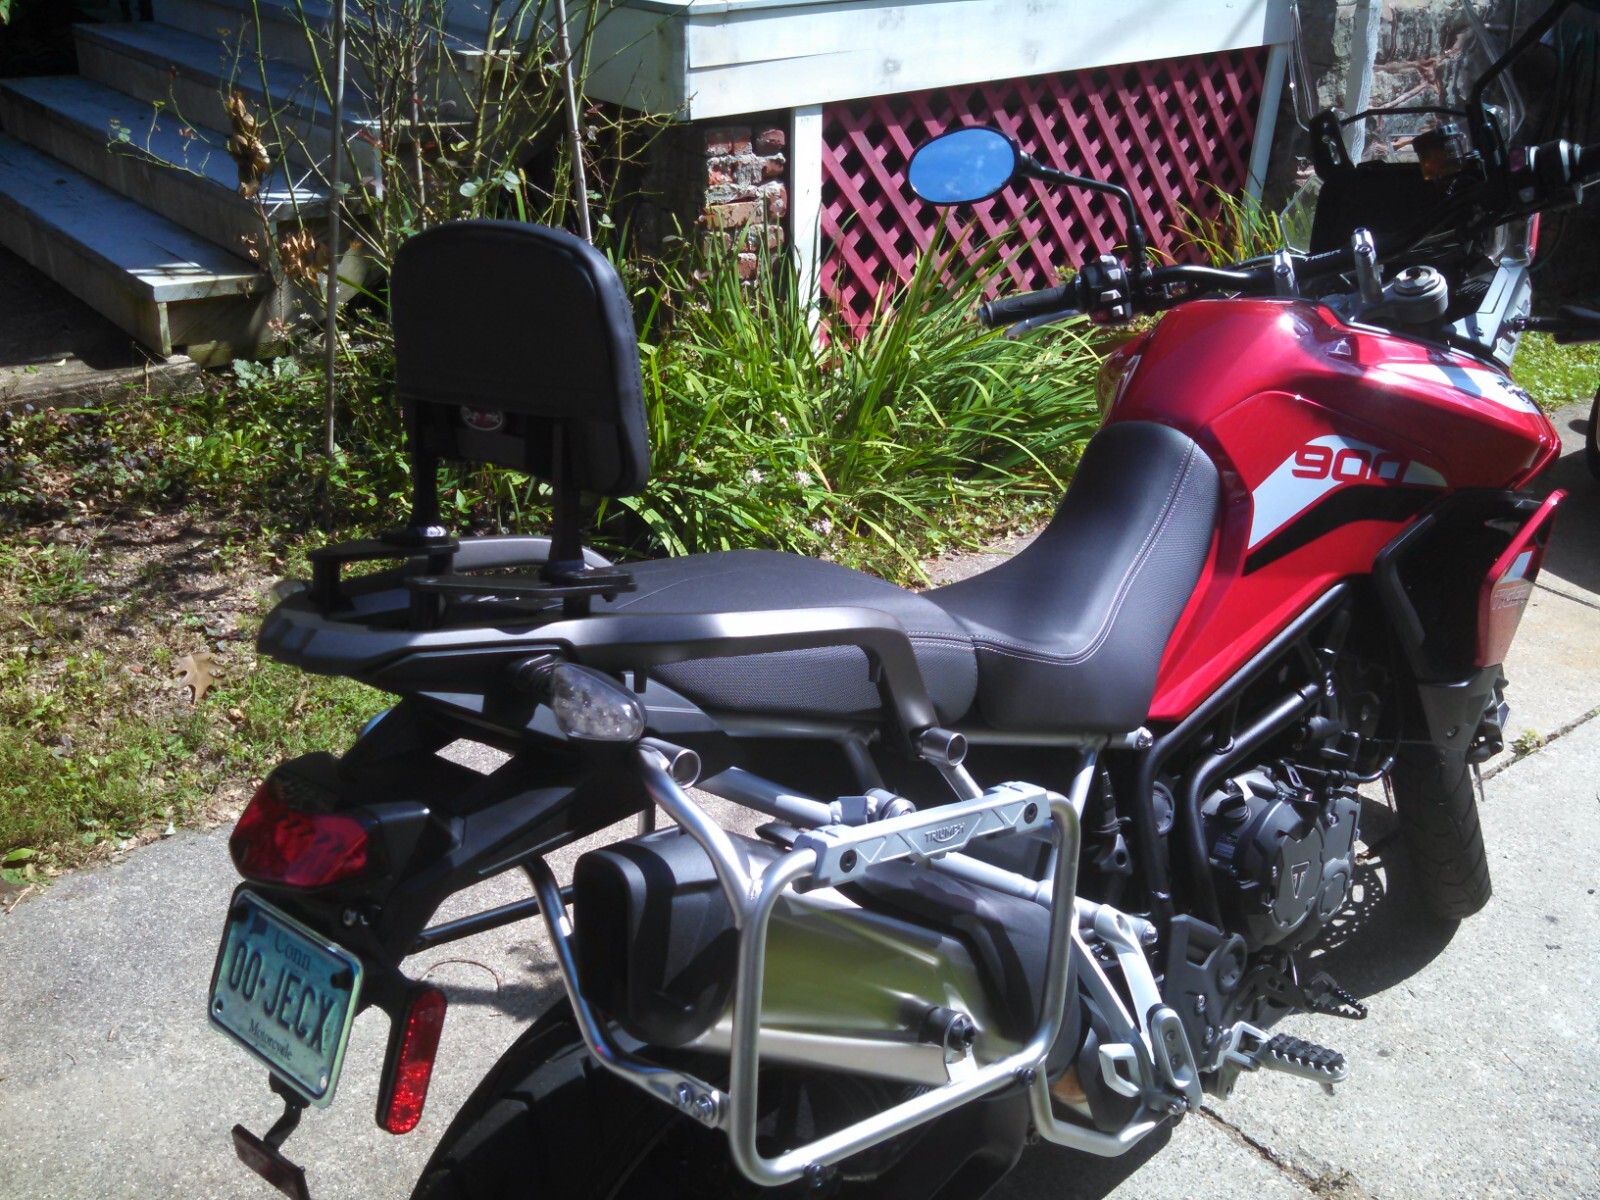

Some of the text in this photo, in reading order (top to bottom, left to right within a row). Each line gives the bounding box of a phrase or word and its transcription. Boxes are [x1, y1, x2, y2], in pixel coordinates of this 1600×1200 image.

[1292, 444, 1411, 485] 900
[924, 822, 966, 843] TRIUMPH
[274, 929, 312, 972] Conn
[249, 1017, 293, 1062] Motorcycle
